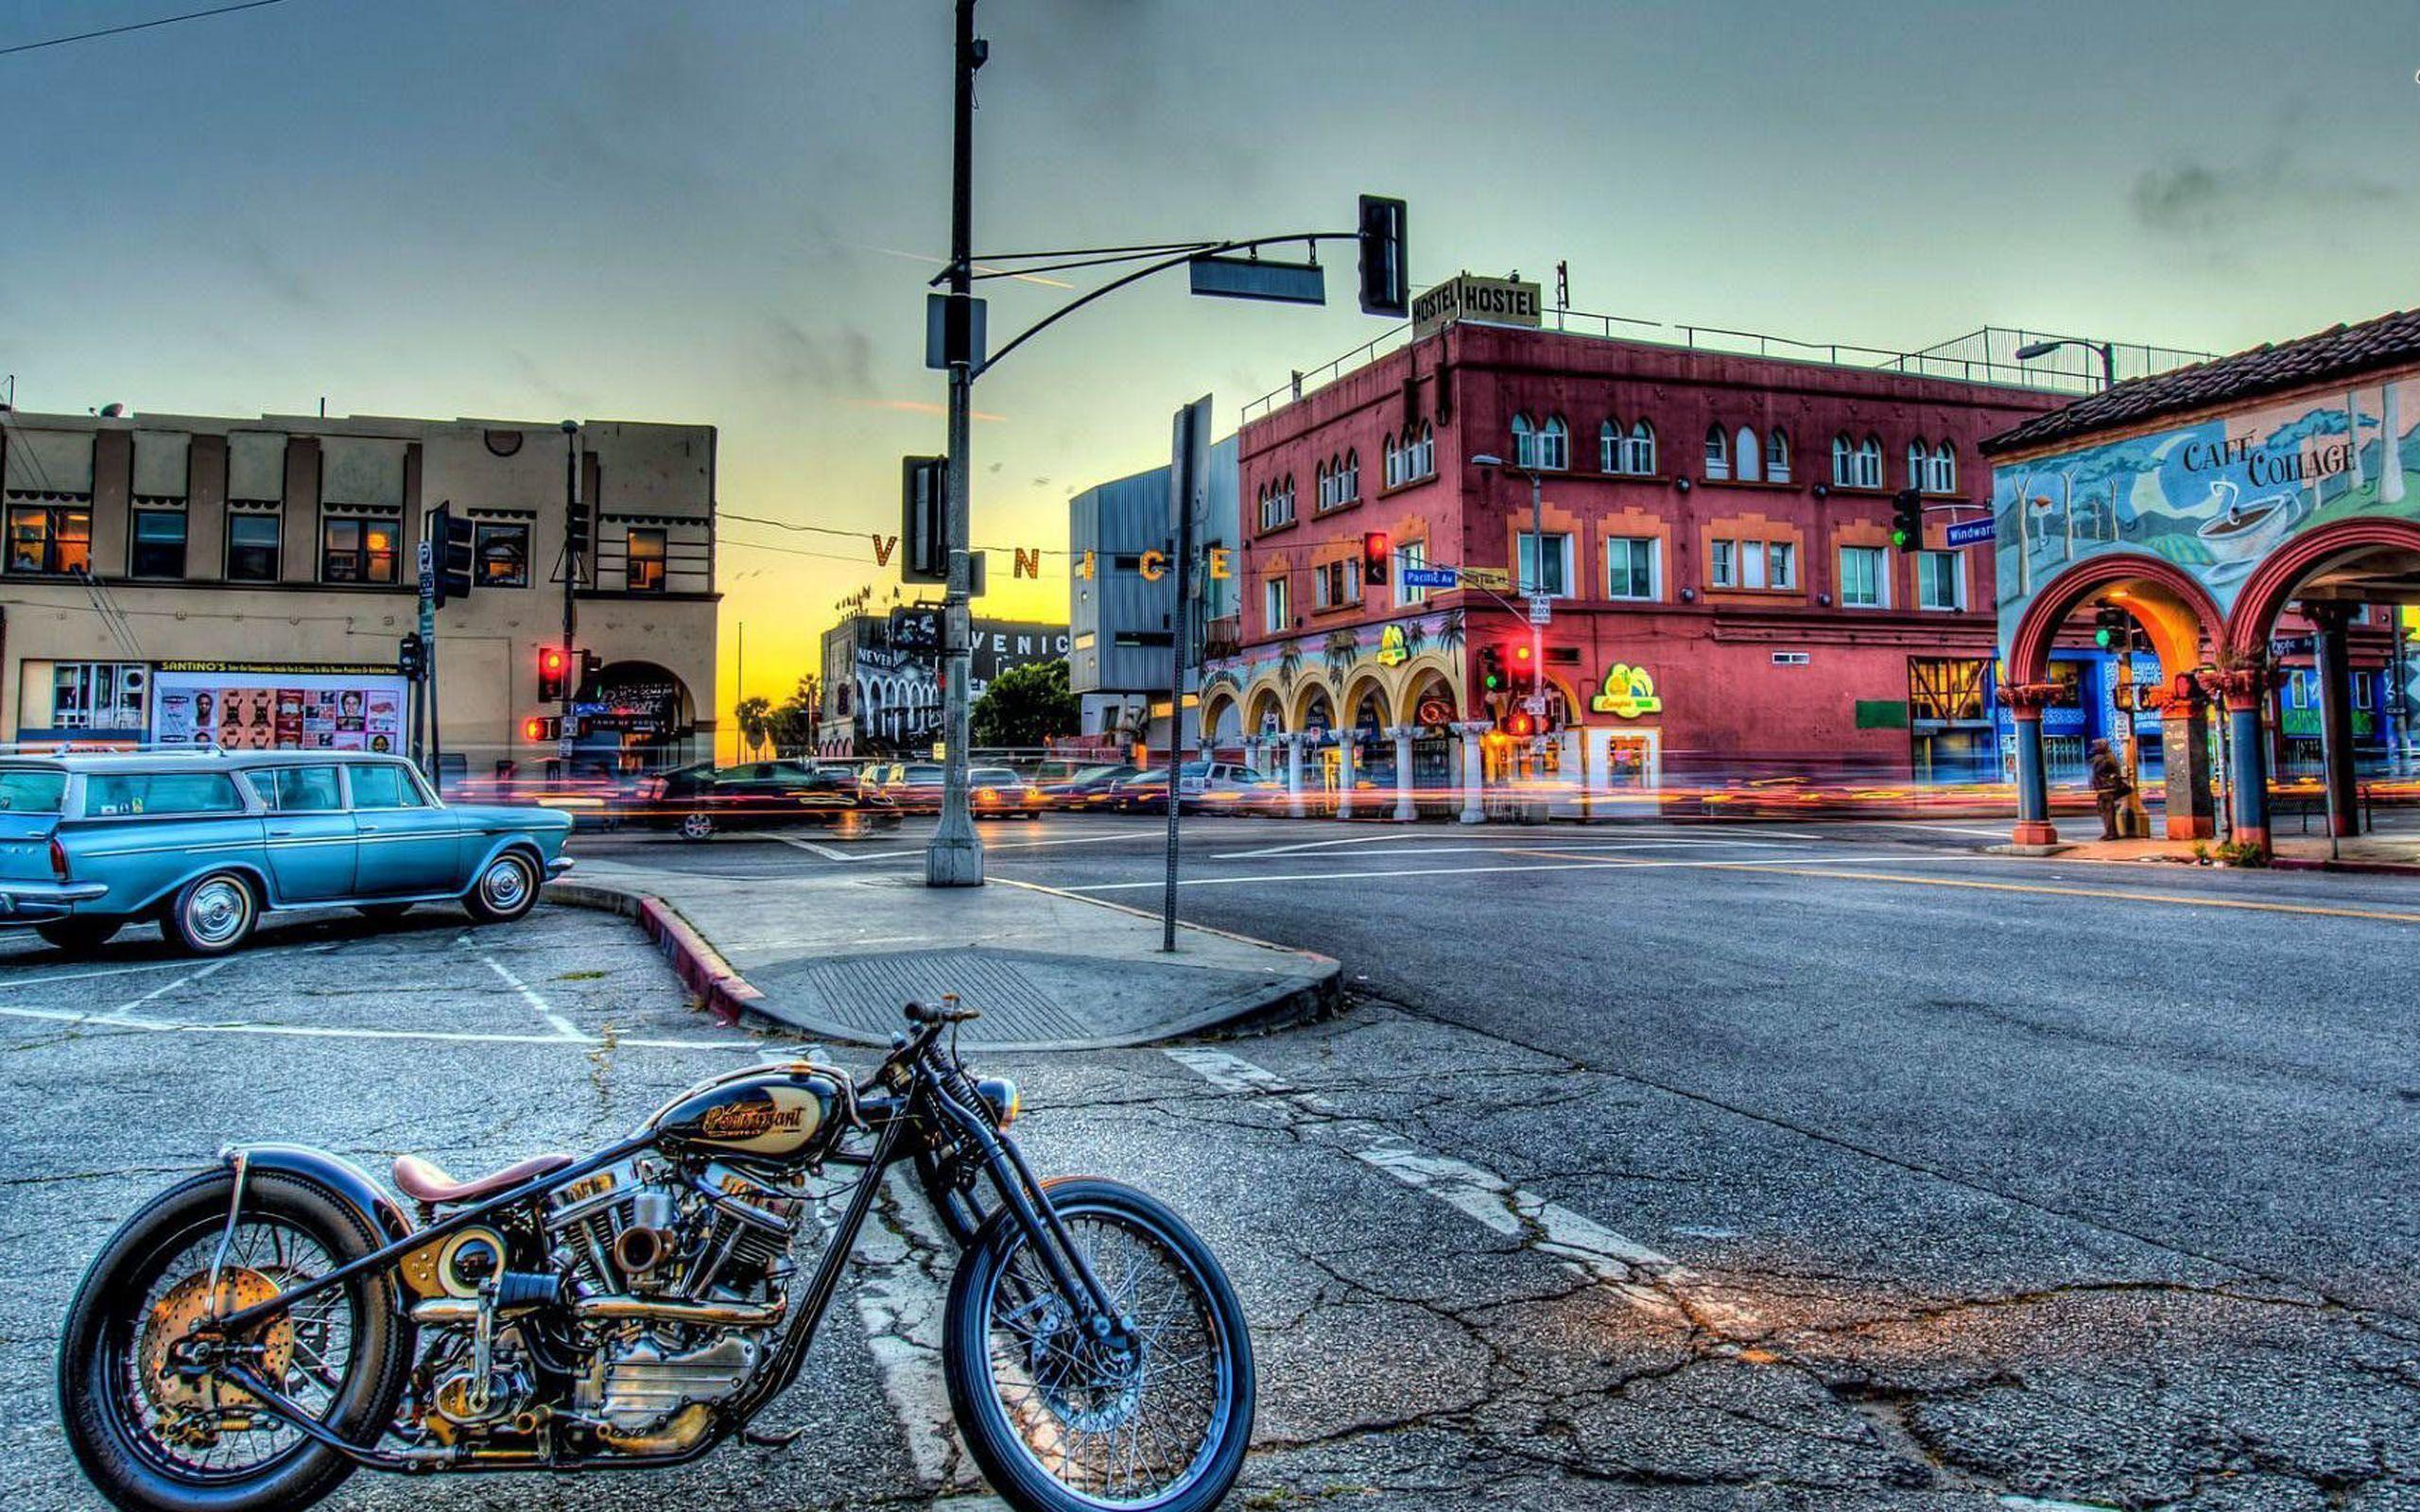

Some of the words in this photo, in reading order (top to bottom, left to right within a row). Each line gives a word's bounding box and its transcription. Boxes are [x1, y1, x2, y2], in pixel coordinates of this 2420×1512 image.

[1412, 284, 1457, 325] HOSTEL
[1466, 285, 1539, 317] HOSTEL
[2248, 442, 2357, 488] COLLAGE
[872, 533, 1231, 581] VNICE
[1408, 571, 1439, 583] Pacific
[971, 630, 1070, 656] VENIC
[162, 662, 226, 672] SANTINO'S
